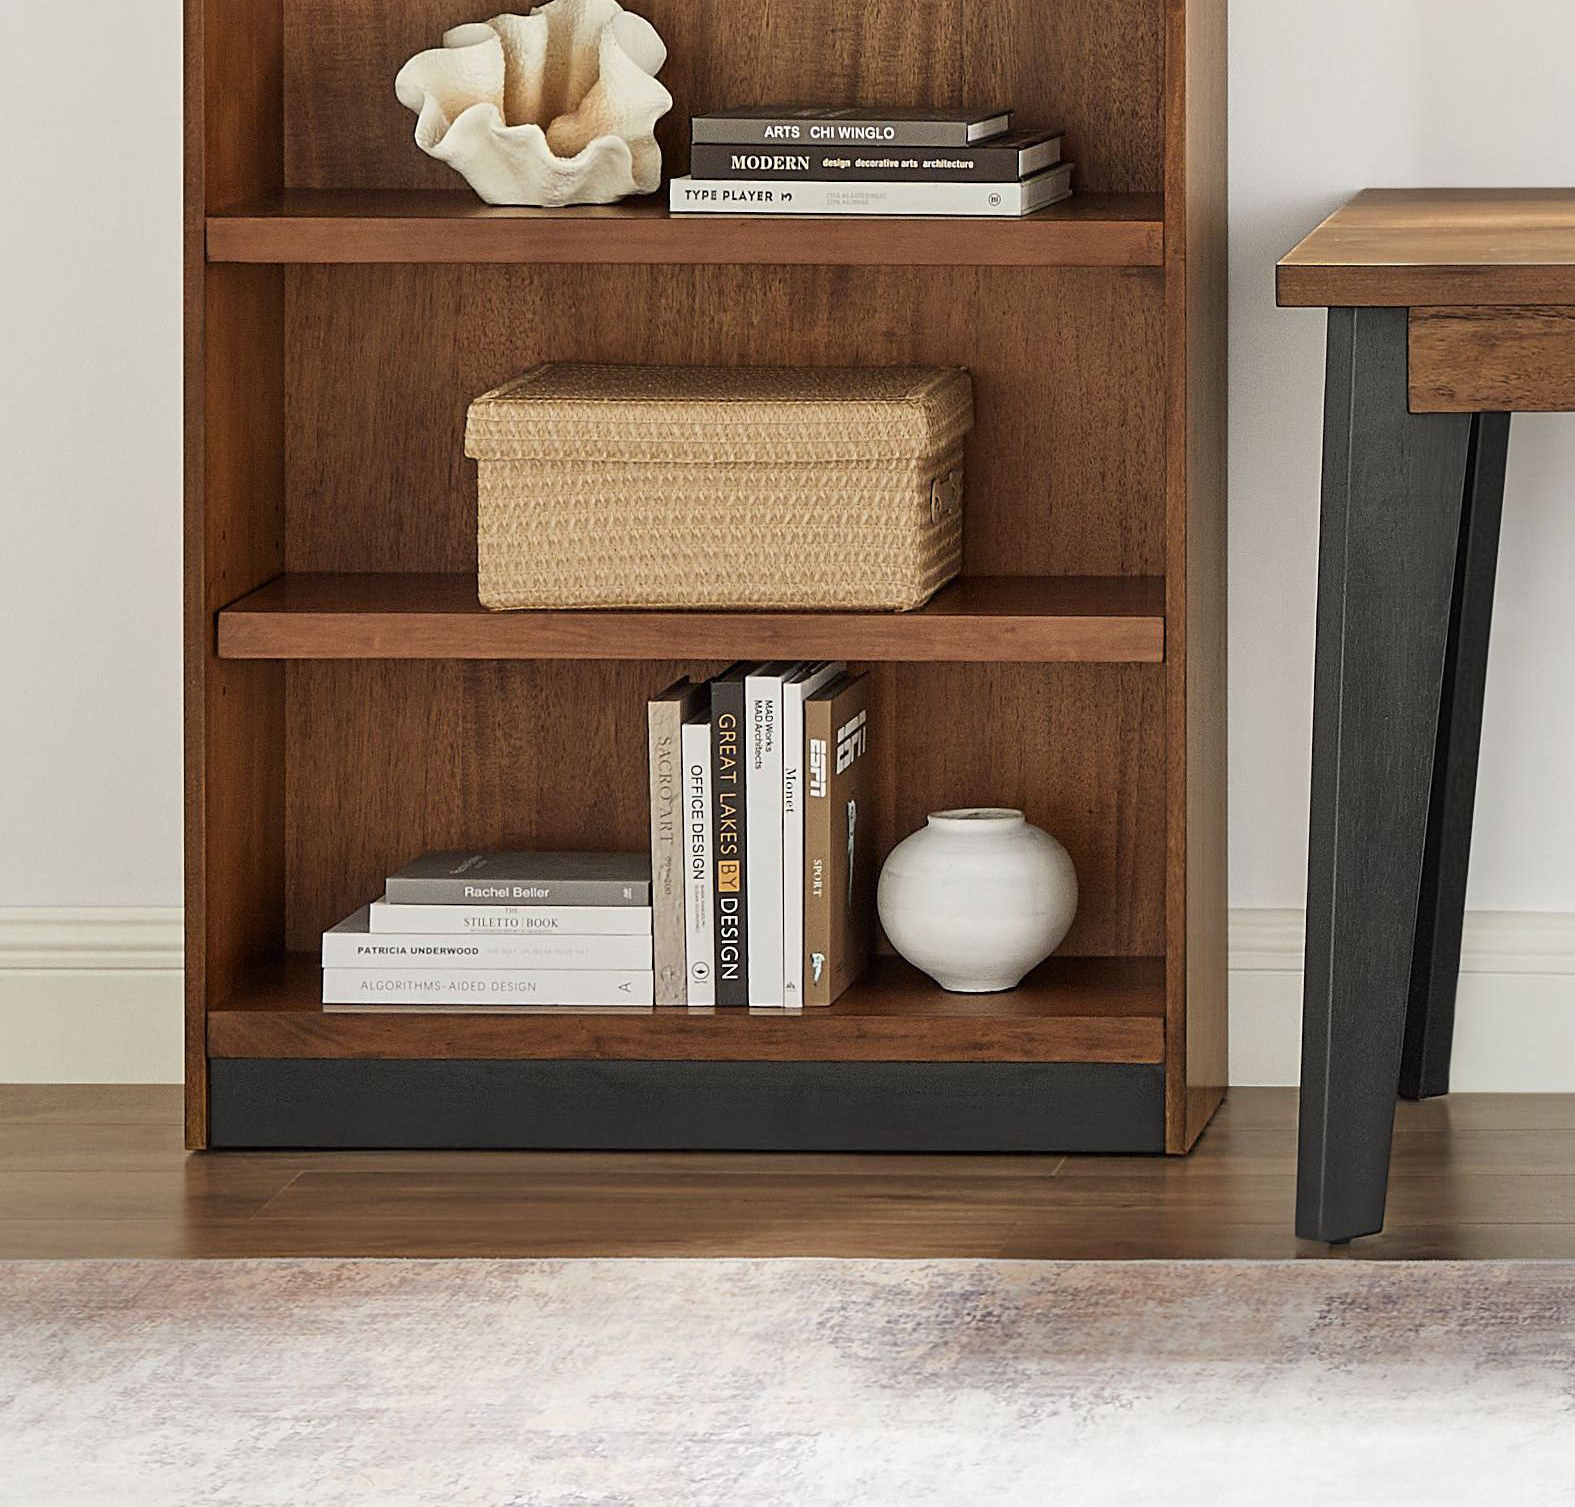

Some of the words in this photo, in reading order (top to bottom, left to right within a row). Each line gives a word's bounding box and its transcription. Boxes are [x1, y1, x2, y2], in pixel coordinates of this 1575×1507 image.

[764, 125, 801, 139] ARTS
[810, 126, 835, 139] CHI
[838, 127, 895, 140] WINGLO
[731, 155, 811, 171] MODERN
[822, 158, 851, 169] design
[855, 158, 899, 168] decorative
[901, 159, 919, 168] arts
[922, 158, 974, 169] architecture
[685, 189, 717, 201] TYPE
[722, 190, 773, 202] PLAYER
[719, 713, 737, 783] GREAT
[754, 723, 763, 770] Architects
[765, 723, 774, 752] Works
[657, 736, 674, 801] SACRO
[810, 739, 827, 797] ESPN
[691, 764, 704, 820] OFFICE
[785, 768, 797, 813] Monet
[719, 793, 738, 854] LAKES
[692, 823, 705, 880] DESIGN
[464, 886, 510, 898] Rachel
[513, 887, 550, 898] Beller
[721, 864, 738, 888] BY
[813, 859, 823, 896] SPORT
[464, 917, 519, 928] STILETTO
[527, 918, 559, 928] BOOK
[720, 897, 739, 979] DESIGN
[357, 946, 407, 955] PATRICIA
[410, 947, 479, 955] UNDERWOOD
[491, 981, 537, 992] DESIGN
